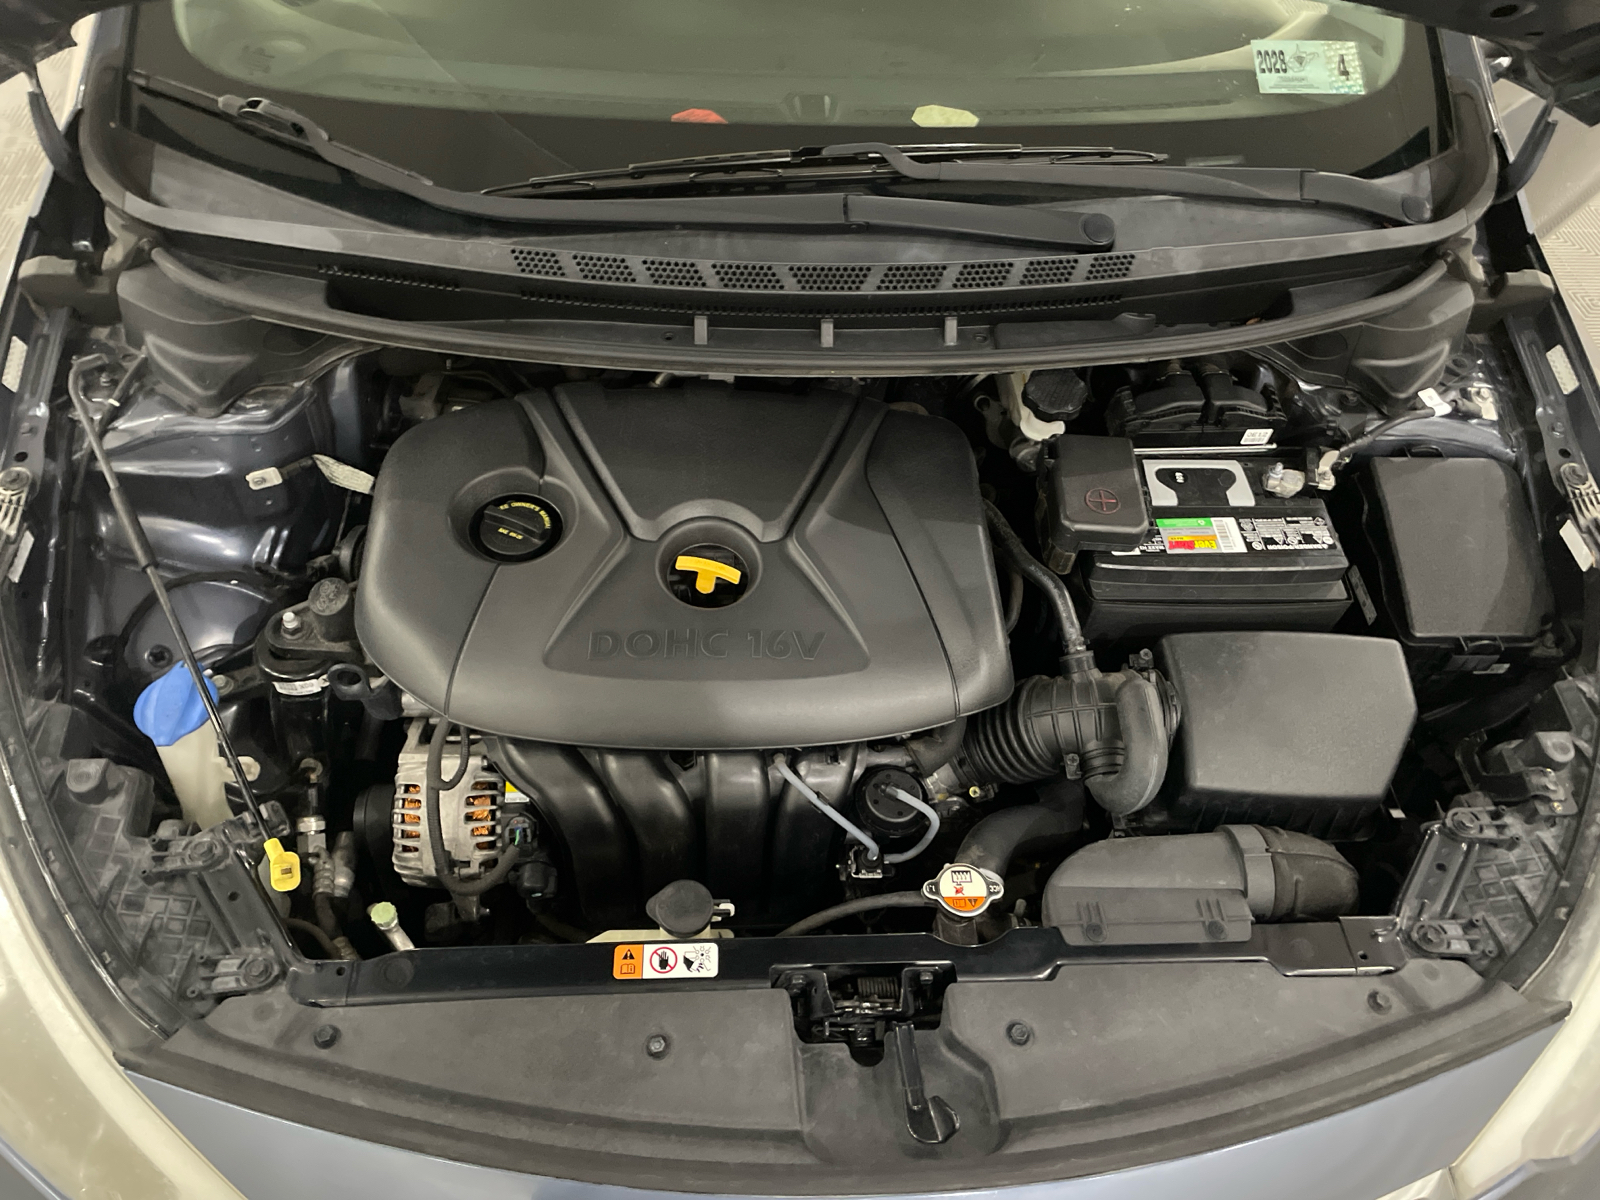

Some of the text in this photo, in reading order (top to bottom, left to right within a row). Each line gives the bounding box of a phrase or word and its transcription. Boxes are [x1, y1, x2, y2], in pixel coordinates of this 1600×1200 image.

[1256, 49, 1288, 74] 2028
[1337, 53, 1350, 81] 4
[1168, 540, 1218, 550] EverStart
[587, 628, 827, 660] DOHC 16V
